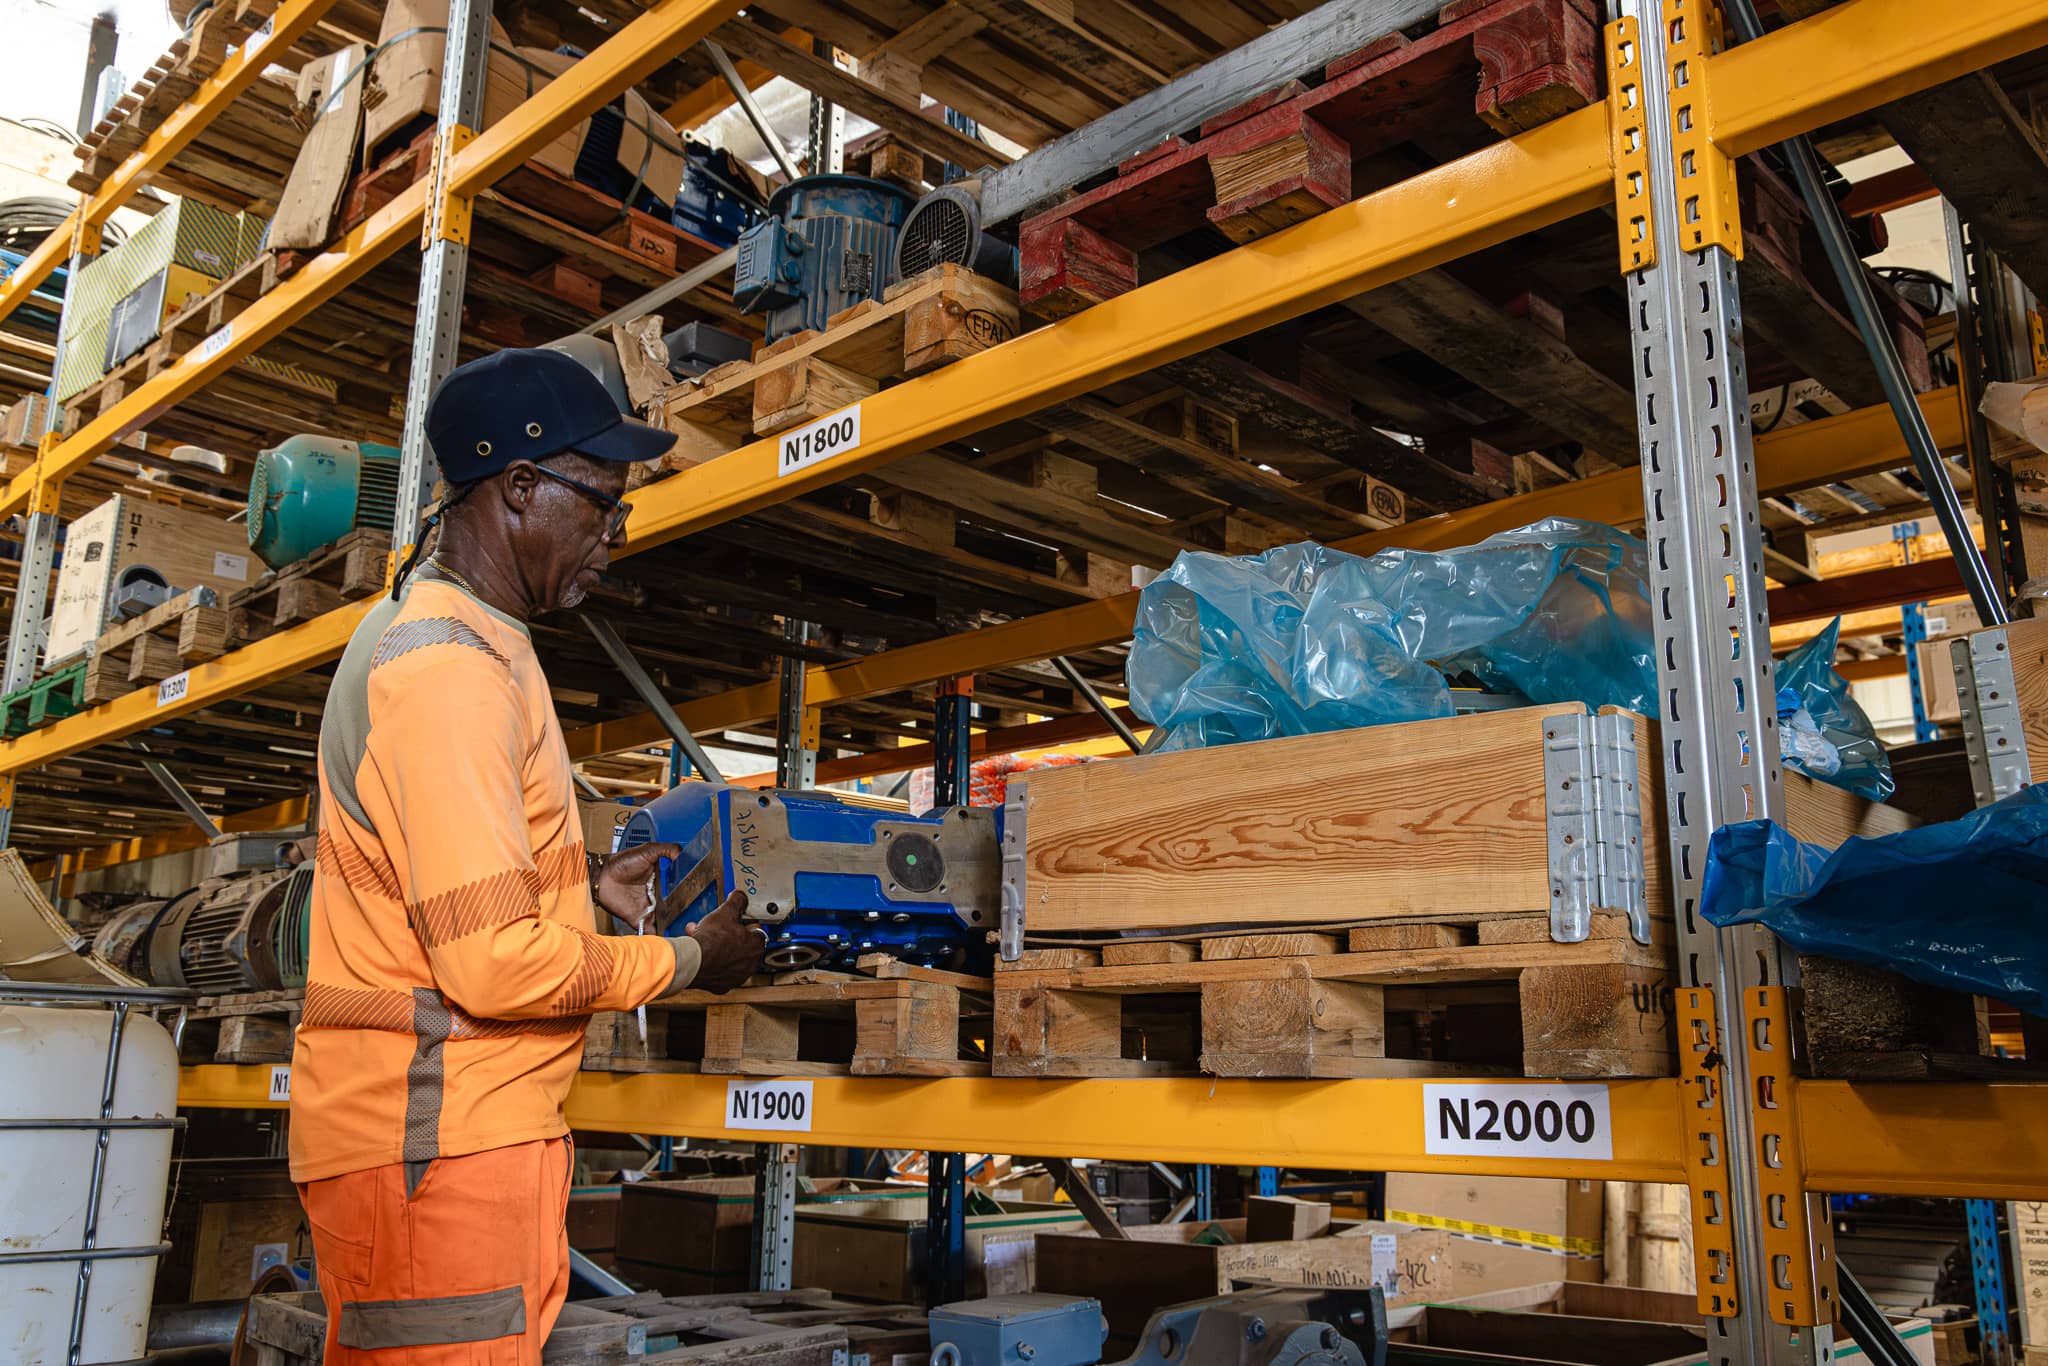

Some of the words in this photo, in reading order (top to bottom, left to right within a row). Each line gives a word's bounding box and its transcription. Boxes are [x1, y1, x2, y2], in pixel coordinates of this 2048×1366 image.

[785, 417, 854, 466] N1800
[160, 678, 186, 701] N1300
[273, 1073, 291, 1094] N1
[733, 1090, 805, 1120] N1900
[1439, 1098, 1595, 1143] N2000
